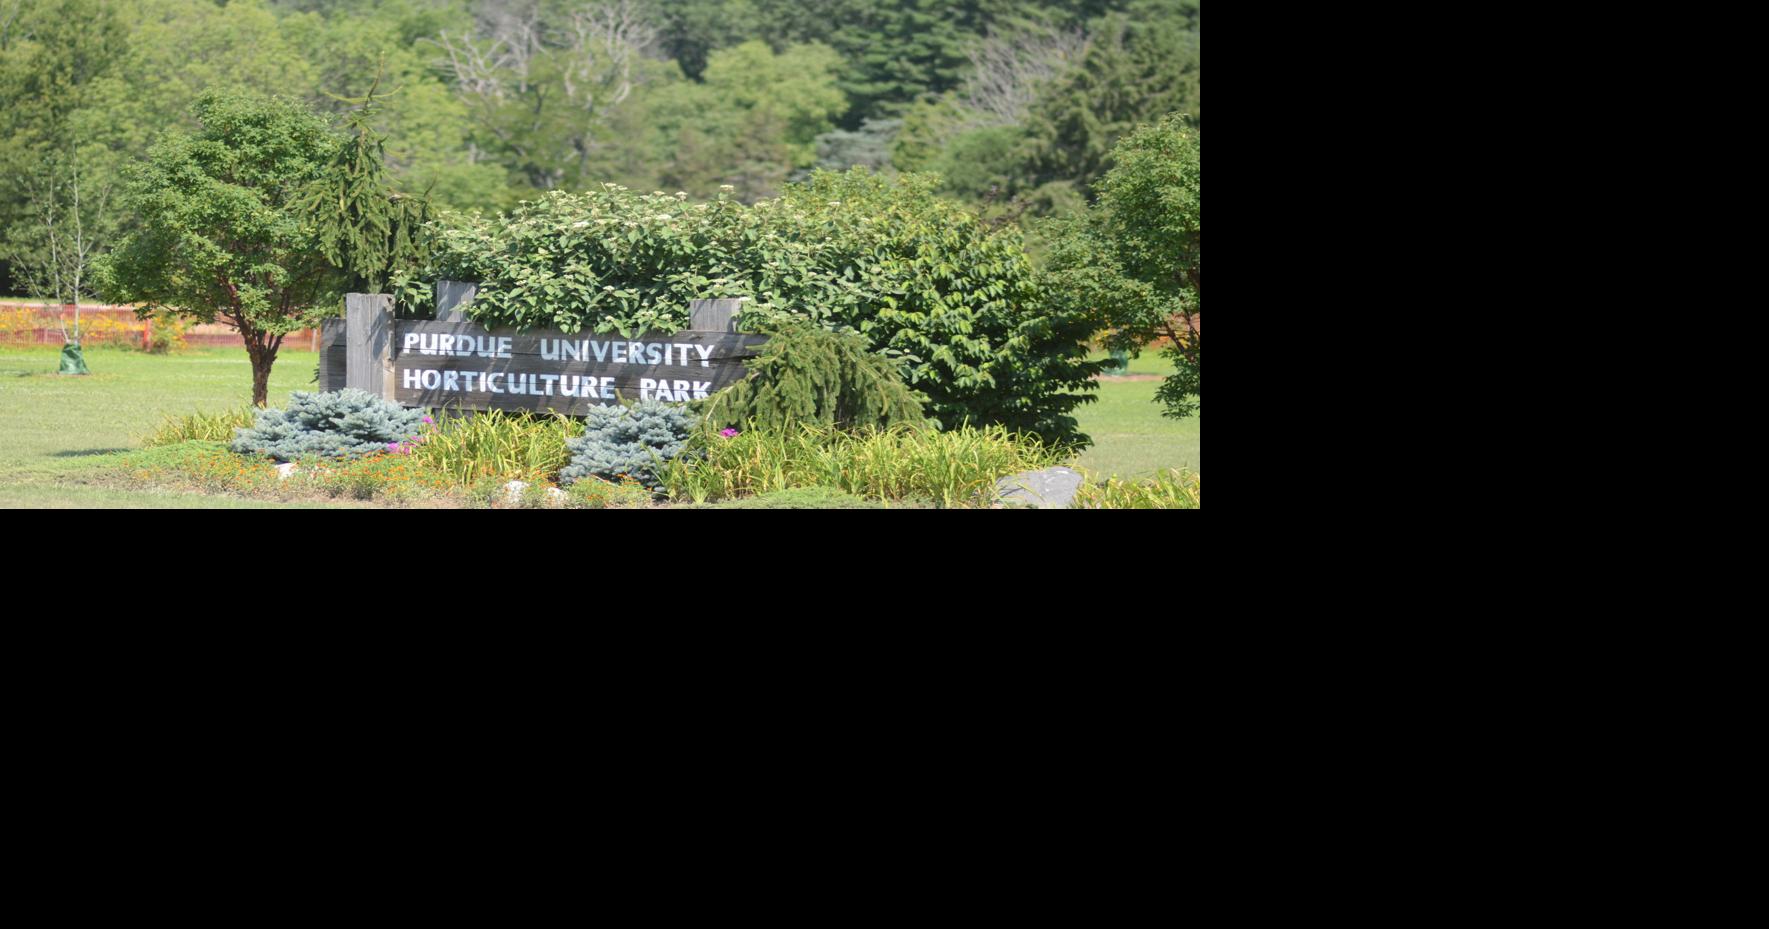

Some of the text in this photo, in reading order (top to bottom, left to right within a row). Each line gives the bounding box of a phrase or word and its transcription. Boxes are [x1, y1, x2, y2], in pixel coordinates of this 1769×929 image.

[403, 333, 714, 368] PURDUE UNIVERSITY
[403, 369, 711, 401] HORTICULTURE PARK
